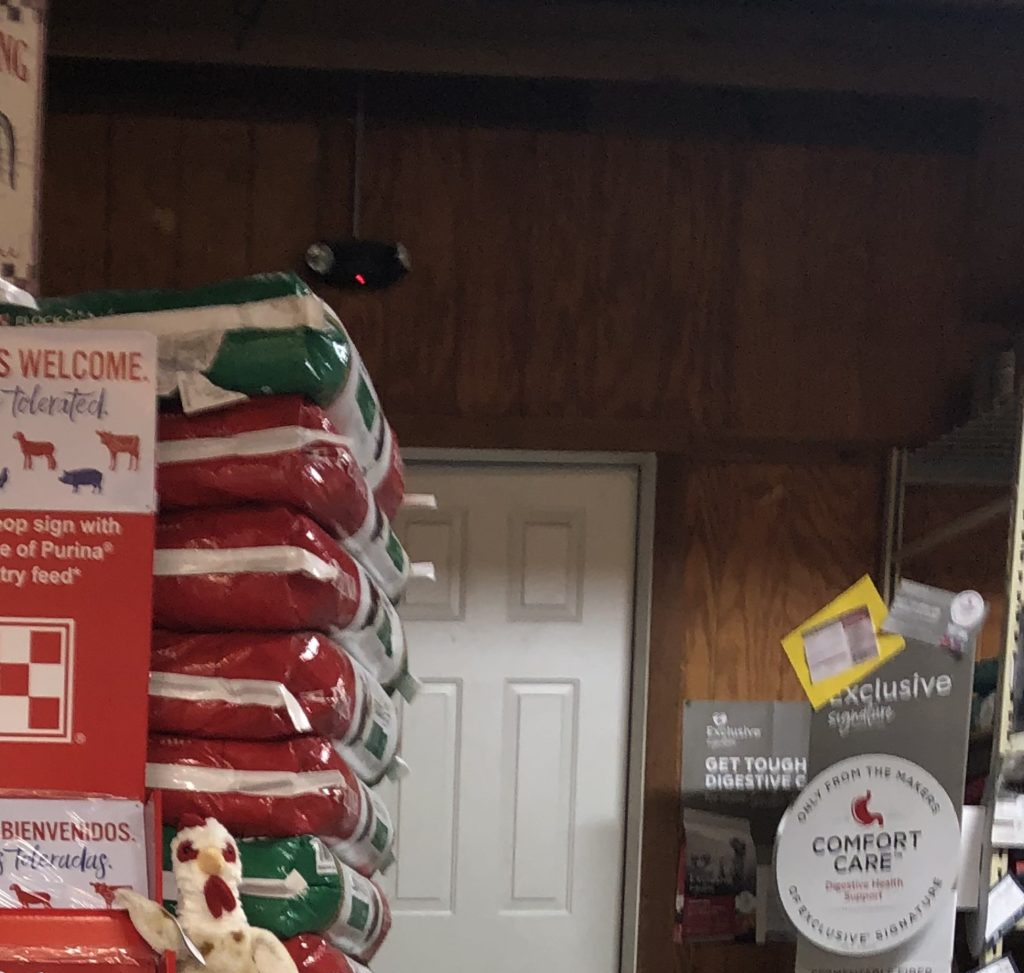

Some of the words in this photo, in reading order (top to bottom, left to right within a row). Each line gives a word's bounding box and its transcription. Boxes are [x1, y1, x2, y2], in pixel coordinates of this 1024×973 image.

[19, 349, 149, 382] WELCOME.
[0, 383, 108, 422] tolerated.
[34, 515, 74, 536] sign
[80, 516, 121, 535] with
[17, 539, 36, 556] of
[705, 757, 740, 773] GET
[744, 757, 807, 773] TOUGH
[705, 774, 791, 790] DIGESTIVE
[797, 789, 821, 824] ONLY
[825, 767, 861, 792] FROM
[866, 766, 891, 778] THE
[896, 770, 941, 816] MAKERS
[1, 821, 136, 843] BIENVENIDOS.
[812, 830, 922, 855] COMFORT
[826, 879, 869, 892] Digestive
[872, 877, 903, 888] Health
[844, 892, 883, 902] Support
[876, 876, 943, 941] SIGNATURE
